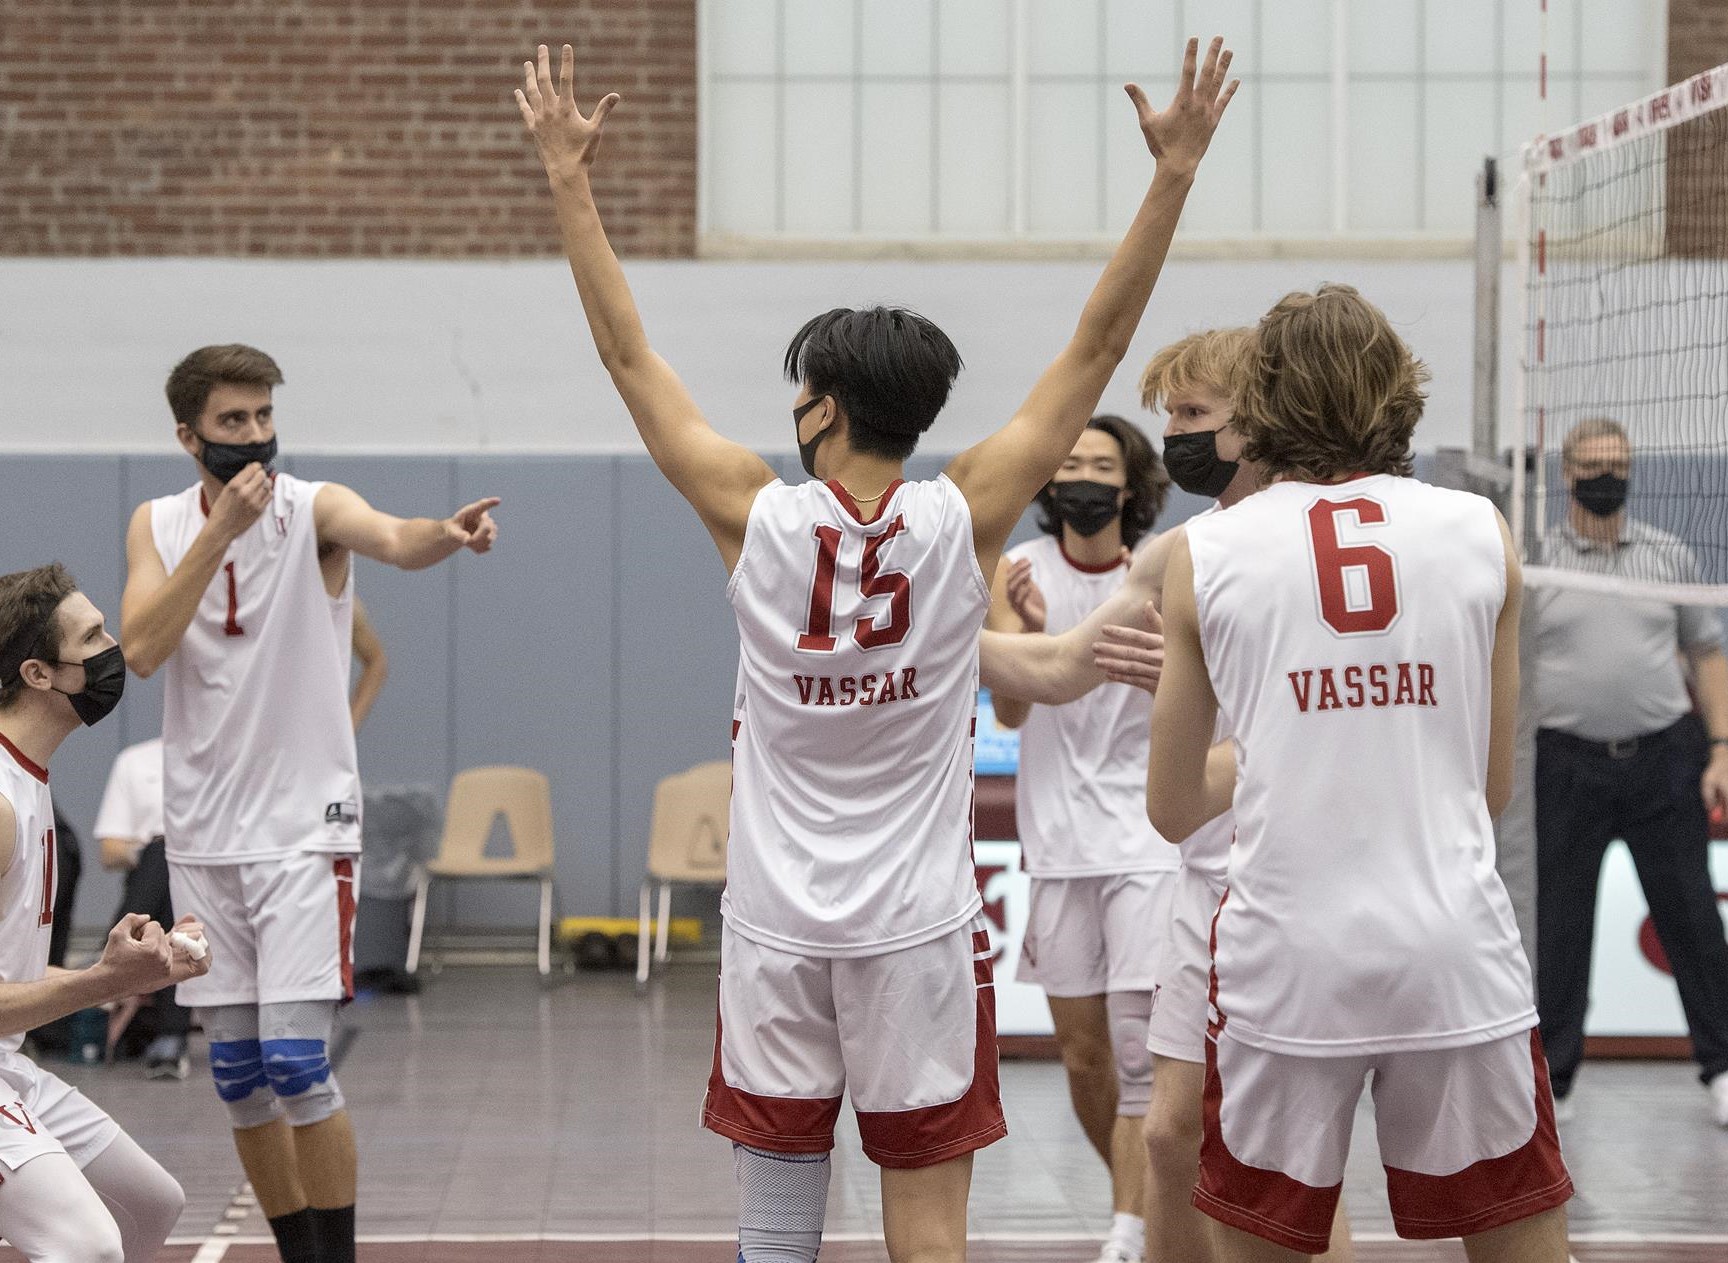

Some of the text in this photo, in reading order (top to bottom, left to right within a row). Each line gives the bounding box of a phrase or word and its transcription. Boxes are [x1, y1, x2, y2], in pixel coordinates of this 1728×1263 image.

[224, 561, 245, 635] 1
[795, 512, 914, 653] 15
[1305, 495, 1401, 637] 6
[793, 667, 919, 706] VASSAR
[1288, 663, 1437, 712] VASSAR
